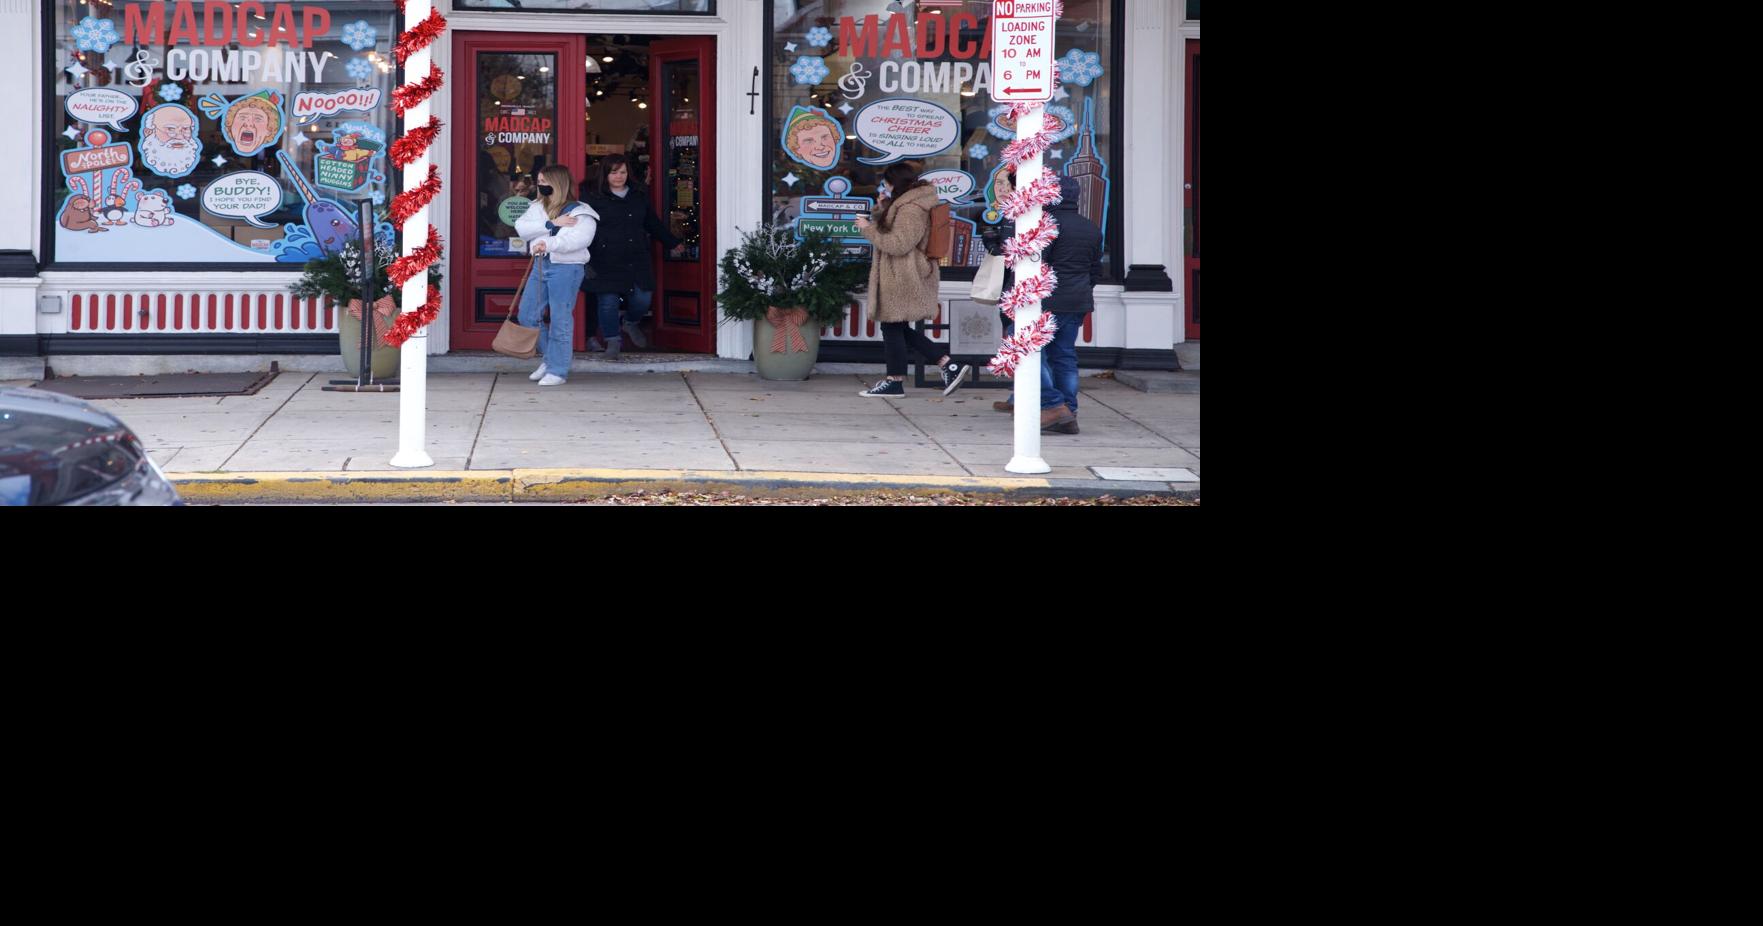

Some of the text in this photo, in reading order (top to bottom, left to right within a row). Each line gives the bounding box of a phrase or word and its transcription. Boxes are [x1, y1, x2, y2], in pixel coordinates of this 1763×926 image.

[996, 1, 1051, 16] NO PARKING
[124, 0, 331, 49] MADCAP
[1001, 21, 1045, 32] LOADING
[1009, 35, 1037, 45] ZONE
[1001, 48, 1041, 58] 10 AM
[124, 49, 332, 88] & COMPANY
[1003, 70, 1040, 80] 6 PM
[838, 61, 991, 100] & COMPA
[72, 103, 129, 113] NAUGHTY
[891, 104, 920, 112] BEST
[484, 116, 551, 132] MADCAP
[871, 116, 943, 128] CHRISTMAS
[888, 125, 931, 134] CHEER
[484, 132, 551, 145] & COMPANY
[879, 133, 918, 141] SINGING
[70, 147, 127, 168] North
[320, 160, 354, 168] COTTON
[320, 165, 354, 174] HEADED
[320, 171, 353, 180] NINNY
[320, 177, 352, 187] MUGGINS
[214, 186, 271, 196] BUDDY!
[935, 184, 962, 194] ING.
[803, 223, 824, 232] New
[827, 224, 848, 233] York
